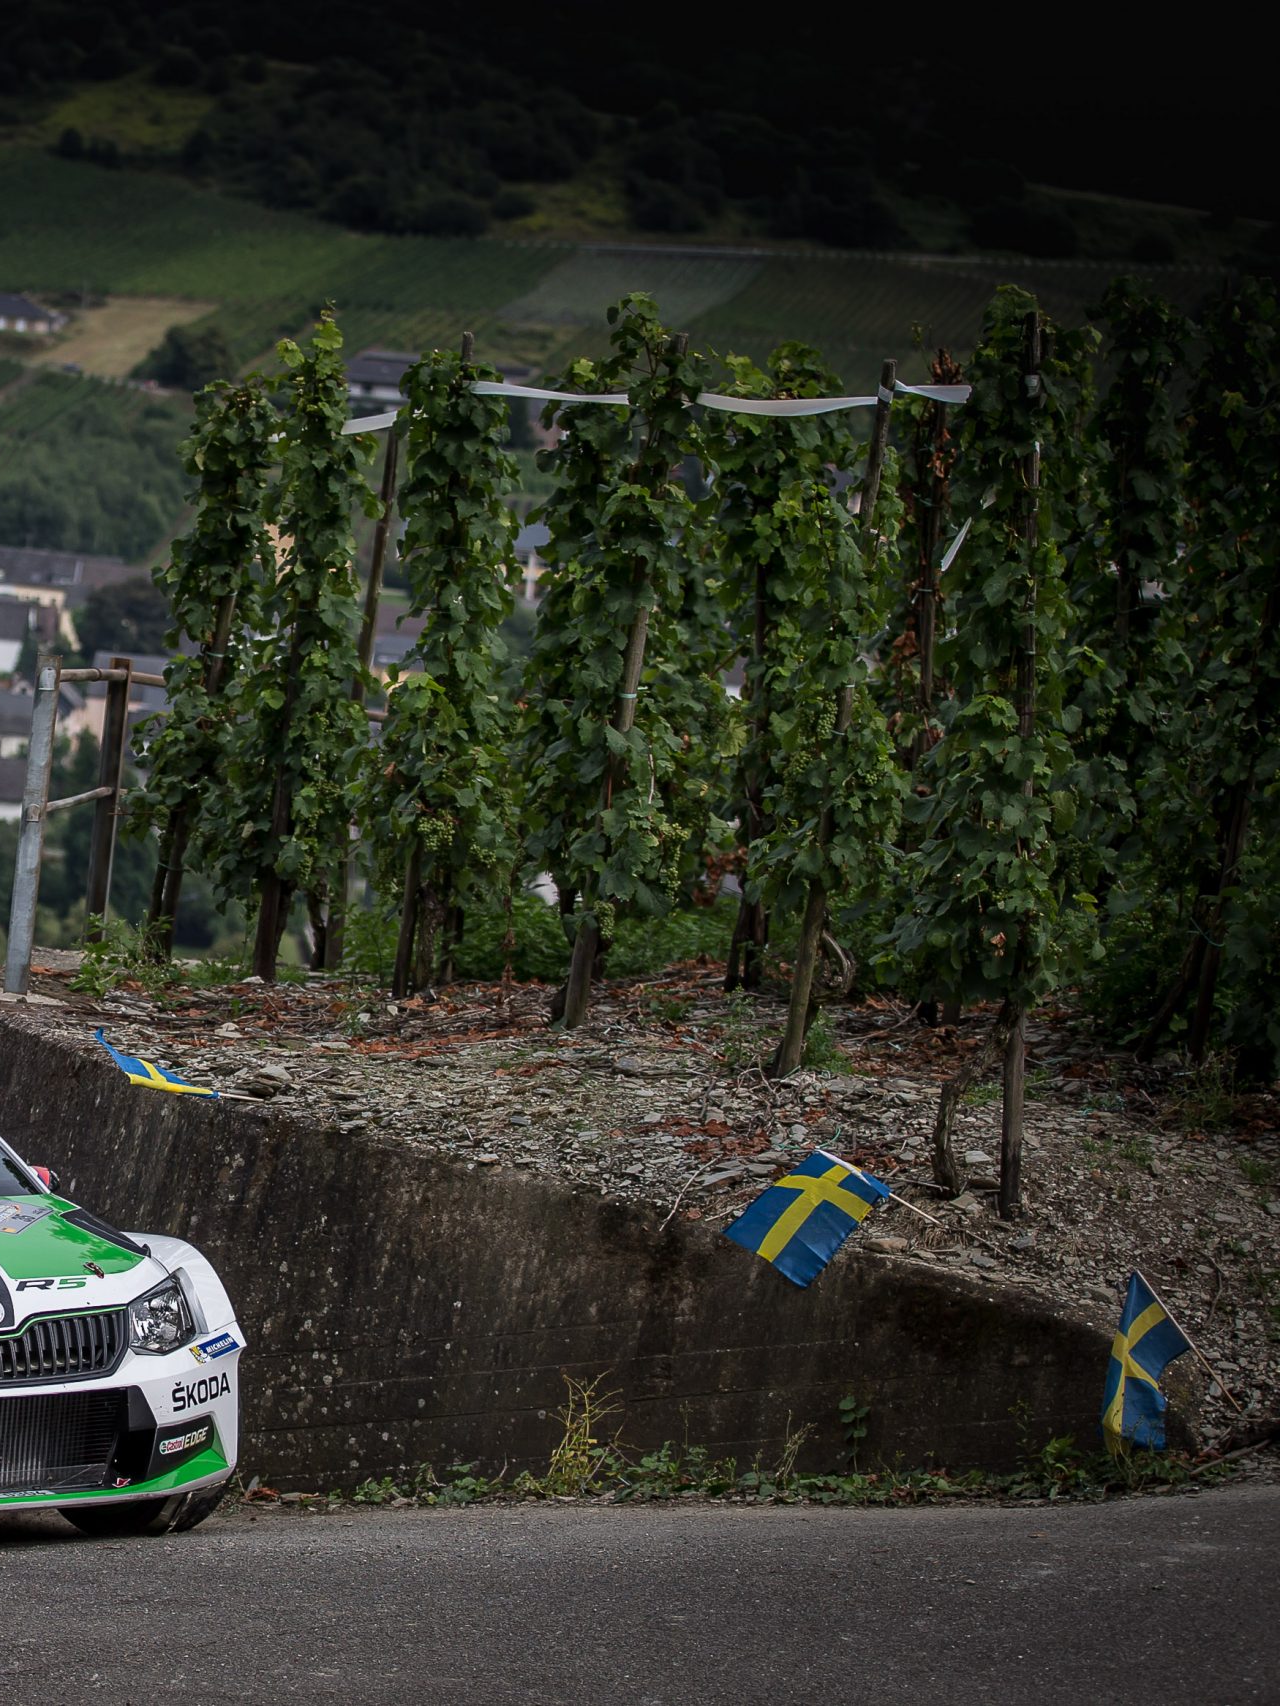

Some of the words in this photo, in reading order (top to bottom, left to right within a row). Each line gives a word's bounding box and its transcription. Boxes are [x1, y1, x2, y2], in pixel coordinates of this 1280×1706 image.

[16, 1277, 87, 1291] R5
[206, 1336, 234, 1353] MICHELIN
[172, 1372, 231, 1412] ŠKODA
[183, 1426, 209, 1448] EDGE
